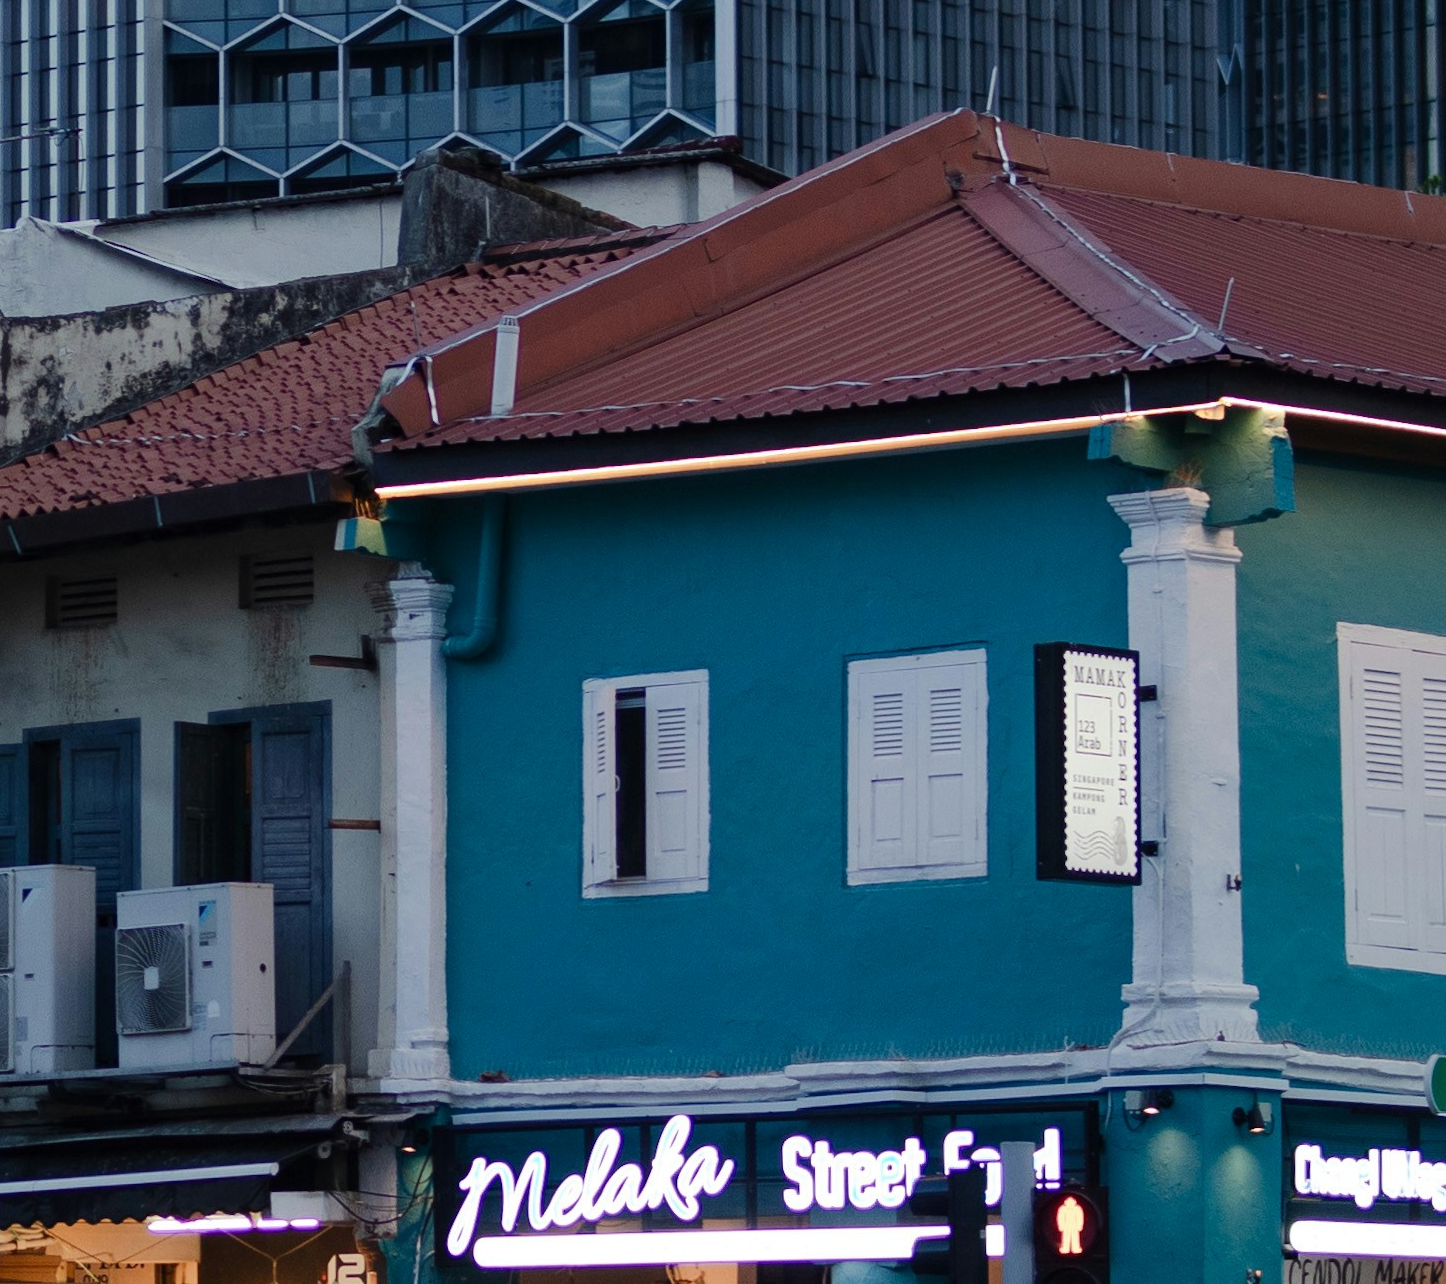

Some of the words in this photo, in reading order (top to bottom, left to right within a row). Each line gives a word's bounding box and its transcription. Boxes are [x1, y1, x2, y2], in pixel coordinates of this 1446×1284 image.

[1074, 665, 1127, 688] MAMAK
[1079, 719, 1096, 734] 123
[1078, 735, 1101, 750] Arab
[1072, 773, 1115, 786] SINGAPORE
[1072, 792, 1106, 803] KAMPONG
[1072, 805, 1096, 816] GELAM
[782, 1135, 926, 1211] Street
[447, 1114, 735, 1256] Melaka
